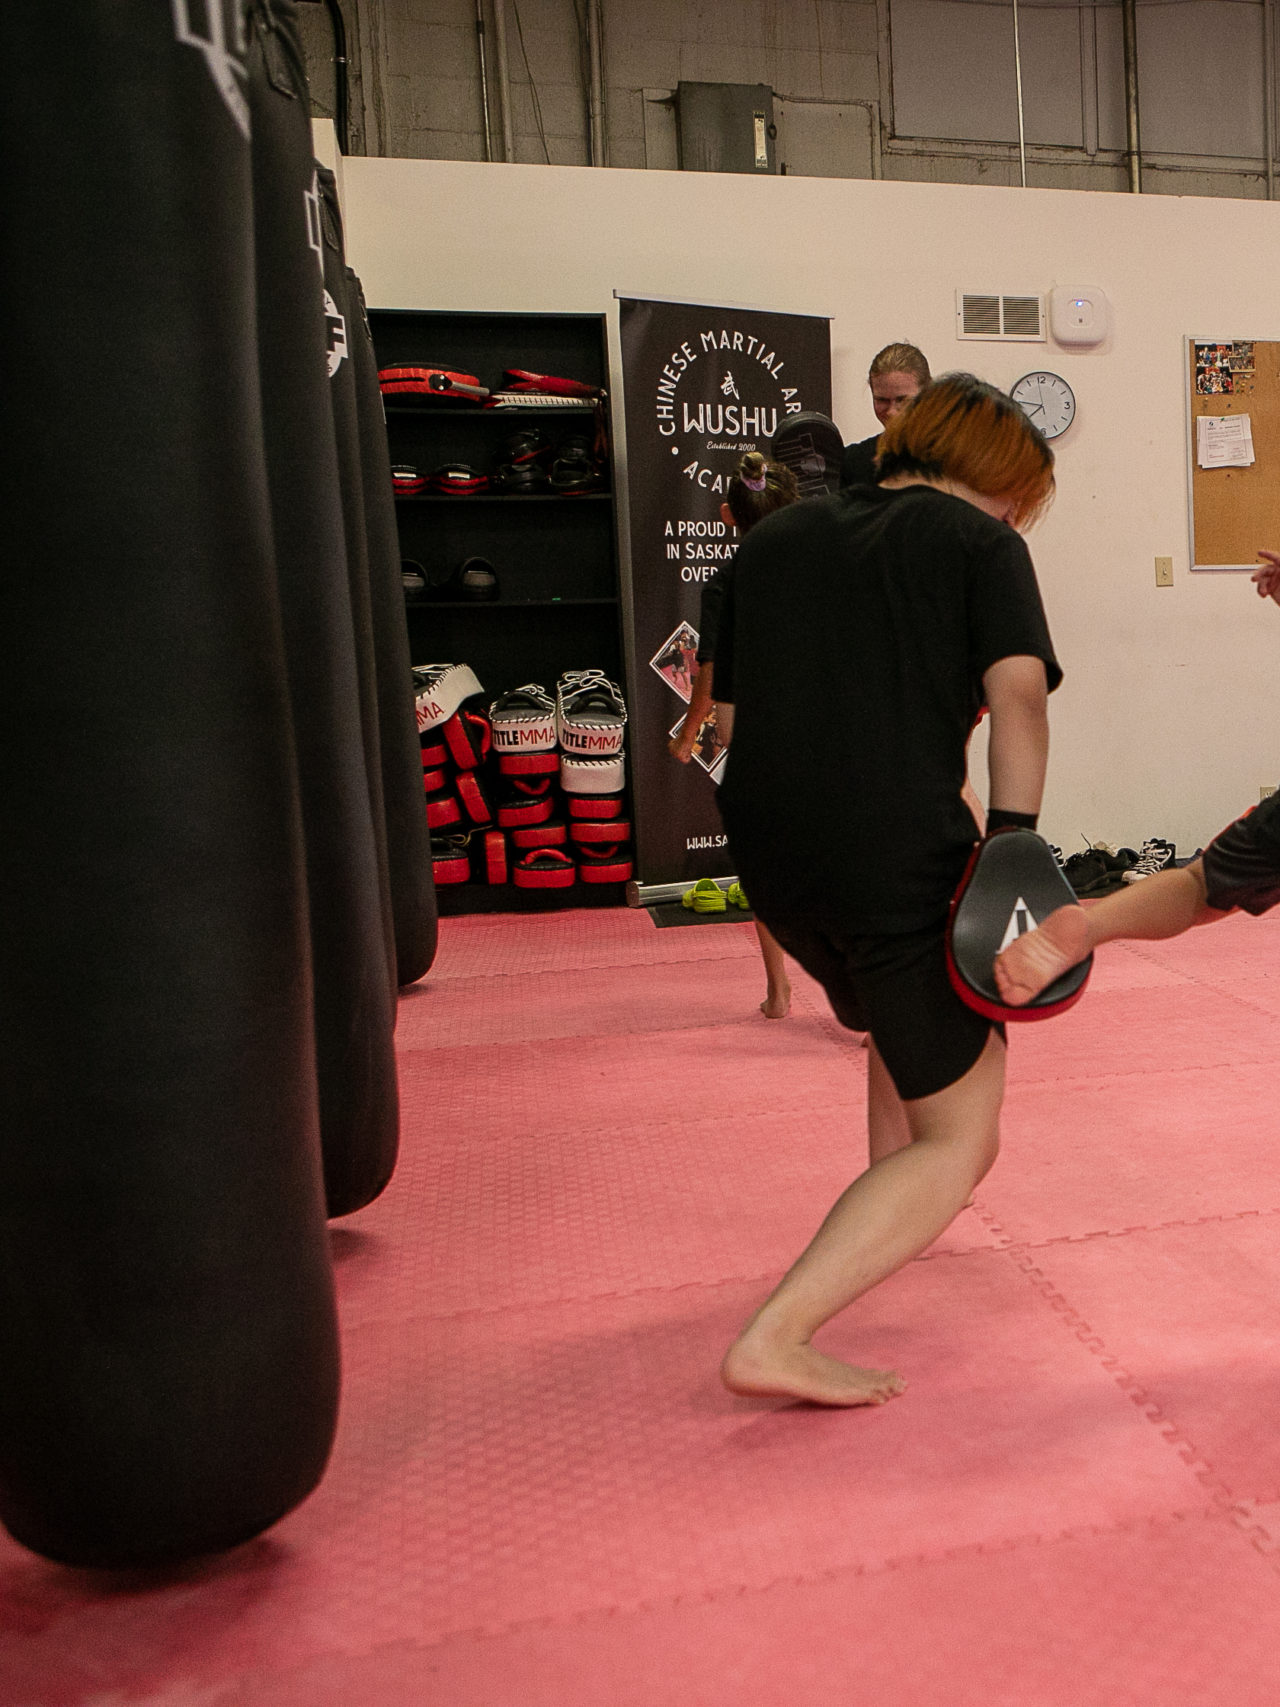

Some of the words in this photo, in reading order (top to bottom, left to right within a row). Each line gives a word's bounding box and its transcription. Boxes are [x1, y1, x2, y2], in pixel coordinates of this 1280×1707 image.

[656, 341, 697, 436] CHINESE
[700, 330, 784, 380] MARTIAL
[1064, 402, 1071, 410] 3
[683, 402, 777, 437] WUSHU
[738, 443, 756, 452] 2000
[683, 460, 733, 494] ACA
[665, 521, 674, 536] A
[678, 521, 726, 537] PROUD
[667, 543, 680, 559] IN
